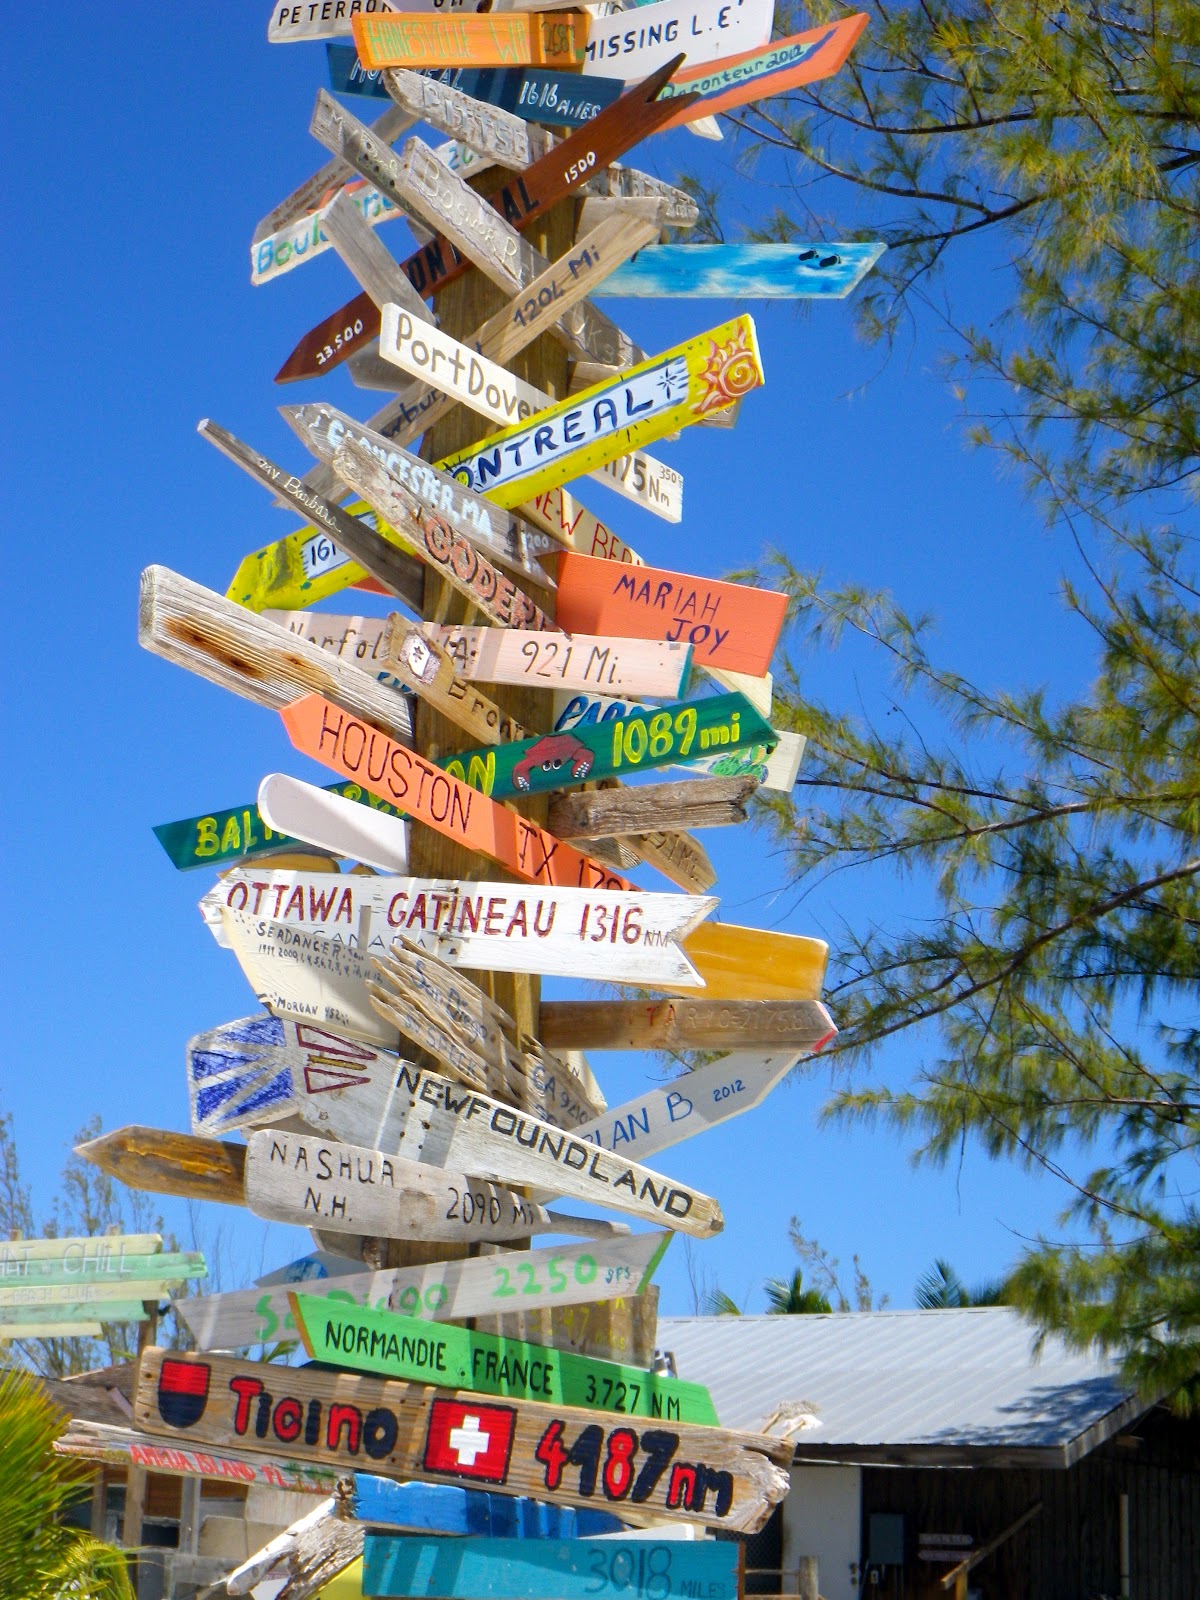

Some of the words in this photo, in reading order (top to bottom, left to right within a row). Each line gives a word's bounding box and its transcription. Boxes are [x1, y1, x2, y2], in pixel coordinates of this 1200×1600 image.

[585, 19, 679, 63] MISSING
[564, 151, 596, 185] 1500
[451, 387, 654, 489] ONTREAL
[612, 574, 722, 623] MARIAH
[521, 641, 573, 679] 921
[666, 618, 730, 656] JOY
[613, 707, 698, 768] 1089
[700, 712, 741, 748] mi
[318, 705, 473, 834] HOUSTON
[226, 881, 353, 925] OTTAWA
[386, 891, 557, 938] GATINEAU
[579, 902, 645, 944] 1316
[665, 1091, 694, 1123] B
[713, 1078, 747, 1102] 2012
[270, 1140, 395, 1188] NASHUA
[396, 1065, 694, 1219] NEWFOUNDLAND
[304, 1187, 353, 1222] N.H.
[446, 1186, 501, 1226] 2090
[491, 1254, 597, 1298] 2250
[325, 1320, 447, 1371] NORMANDIE
[472, 1348, 555, 1395] FRANCE
[651, 1391, 681, 1421] NM
[584, 1545, 673, 1600] 3018
